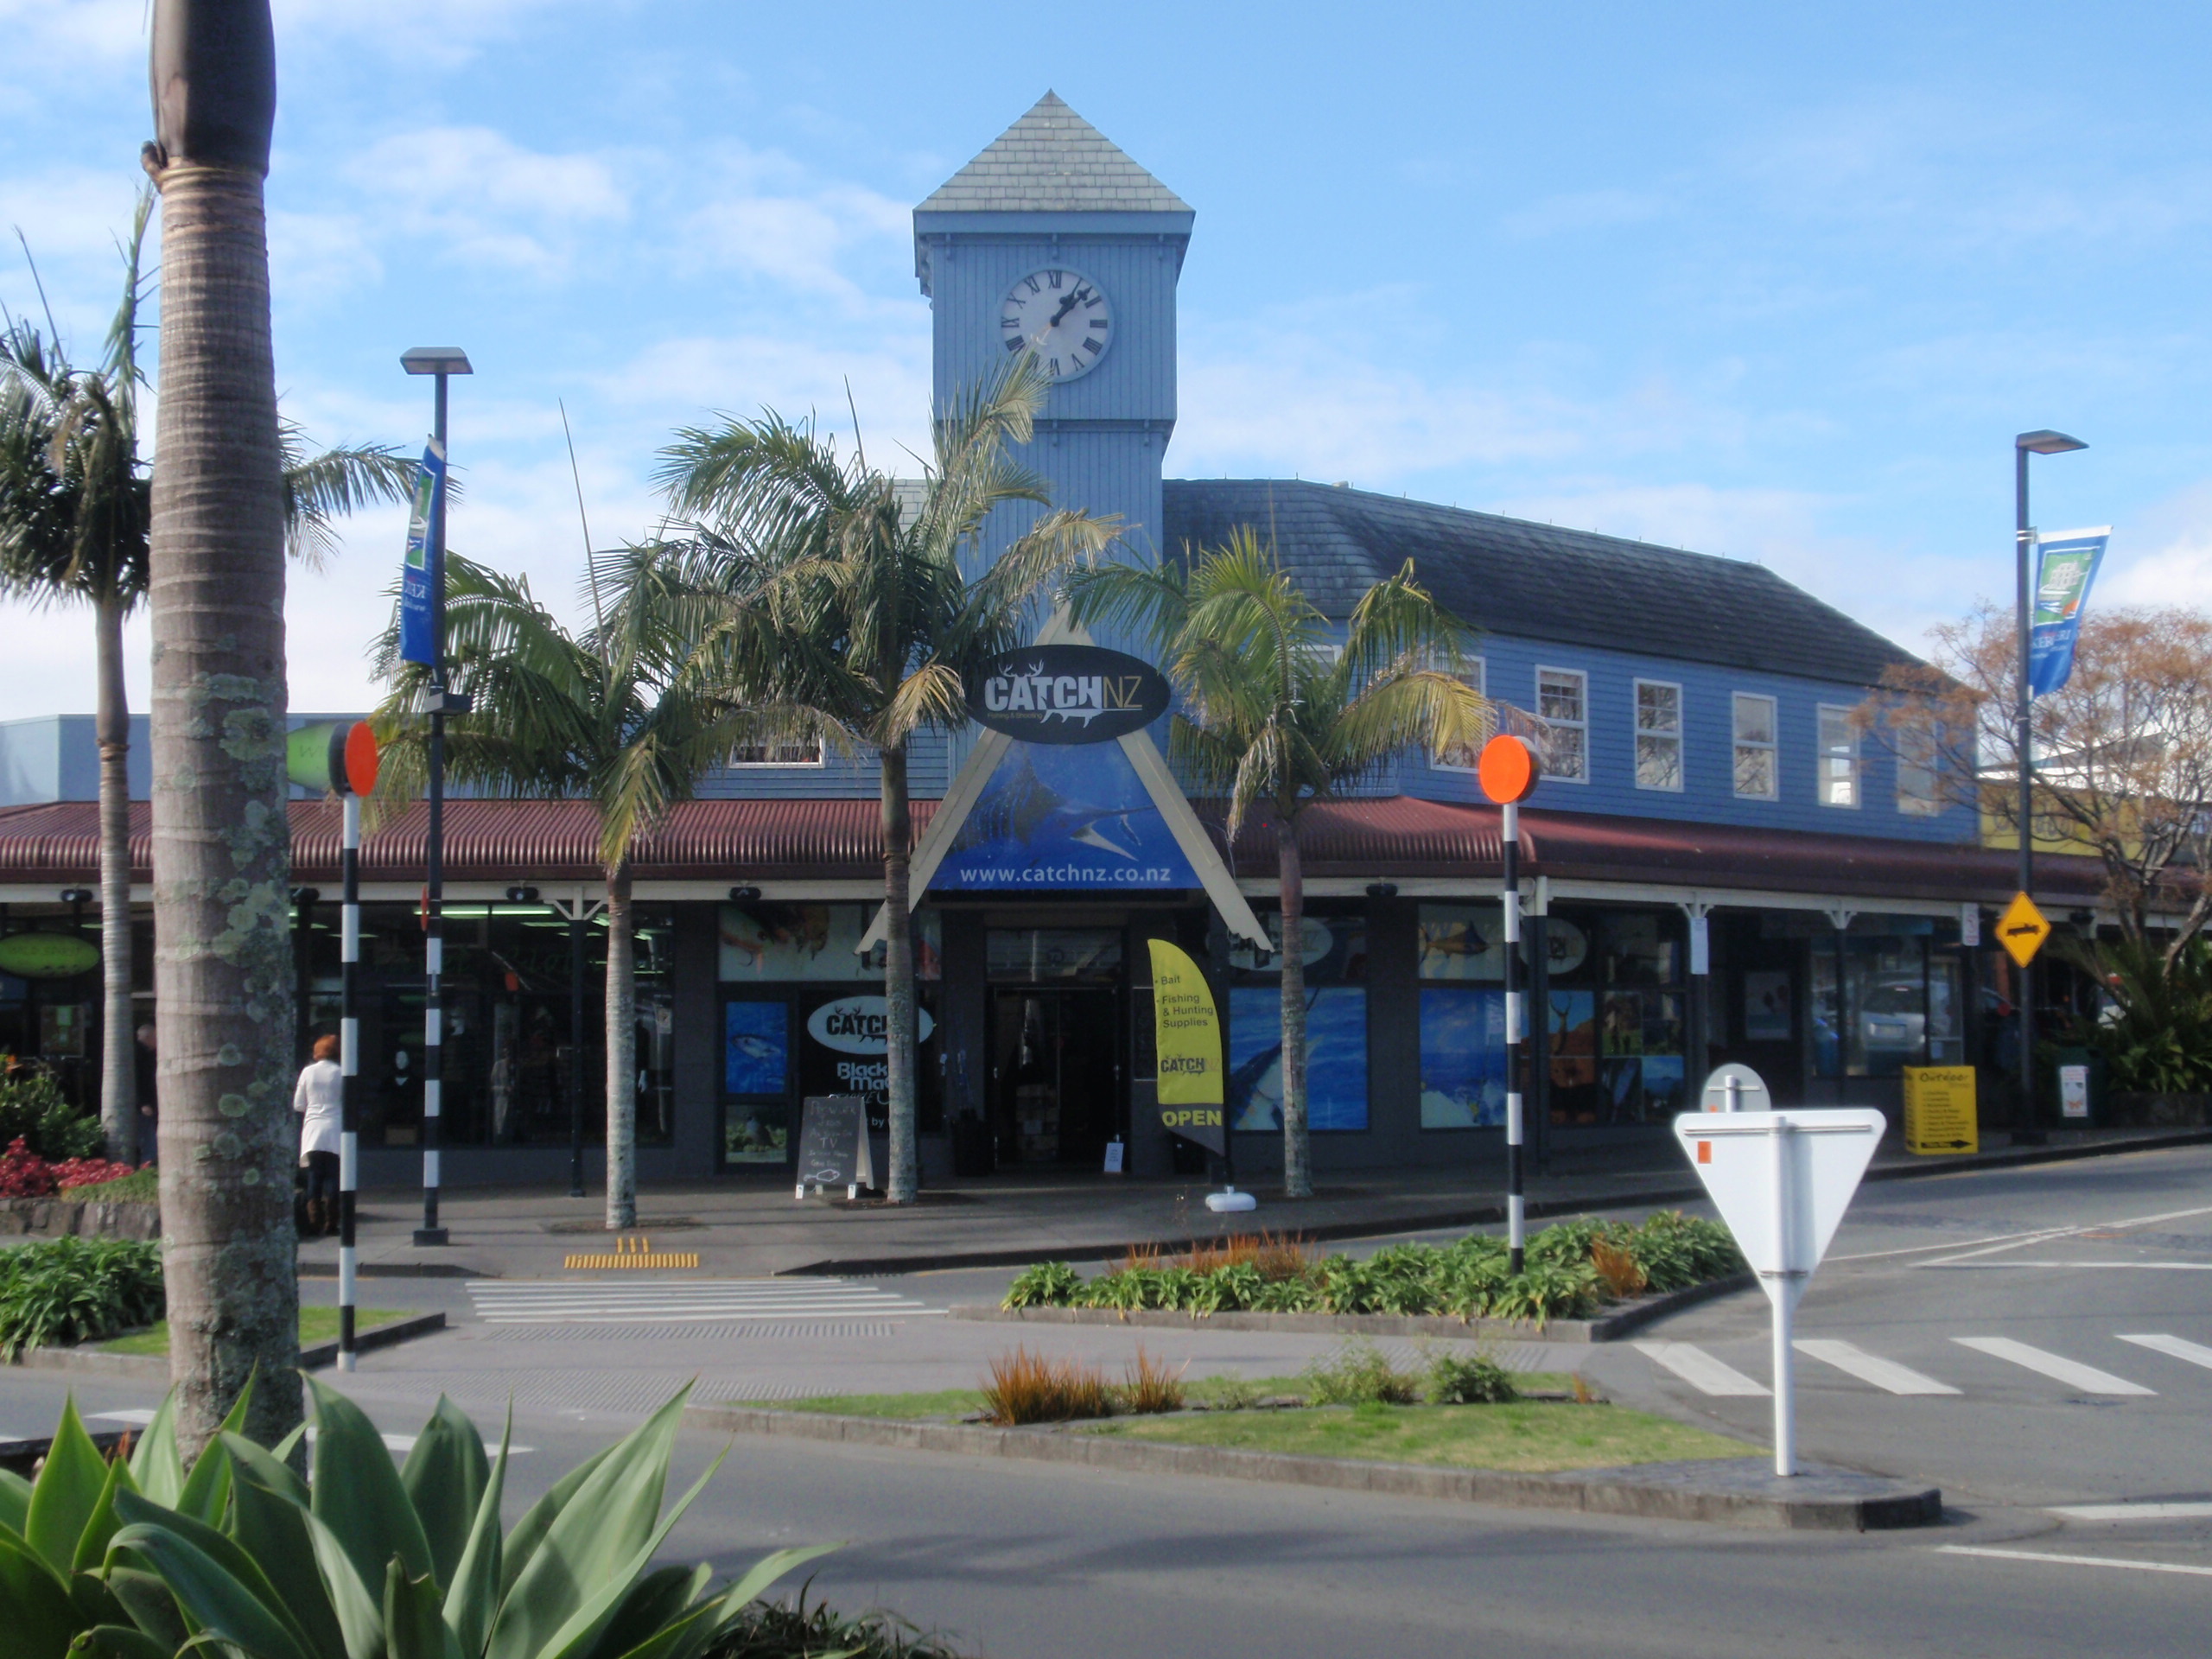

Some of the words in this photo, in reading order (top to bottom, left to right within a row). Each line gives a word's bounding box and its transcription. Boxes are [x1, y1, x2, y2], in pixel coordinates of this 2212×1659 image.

[960, 864, 1171, 883] www.catchnz.co.nz
[1160, 975, 1181, 986] Bait
[1161, 994, 1200, 1006] Fishing
[1162, 1007, 1170, 1017] &
[1173, 1005, 1214, 1018] Hunting
[1163, 1018, 1208, 1030] Supplies
[836, 1062, 888, 1080] Black
[1920, 1071, 1968, 1083] Outdoor
[871, 1116, 885, 1128] by
[1162, 1109, 1223, 1128] OPEN
